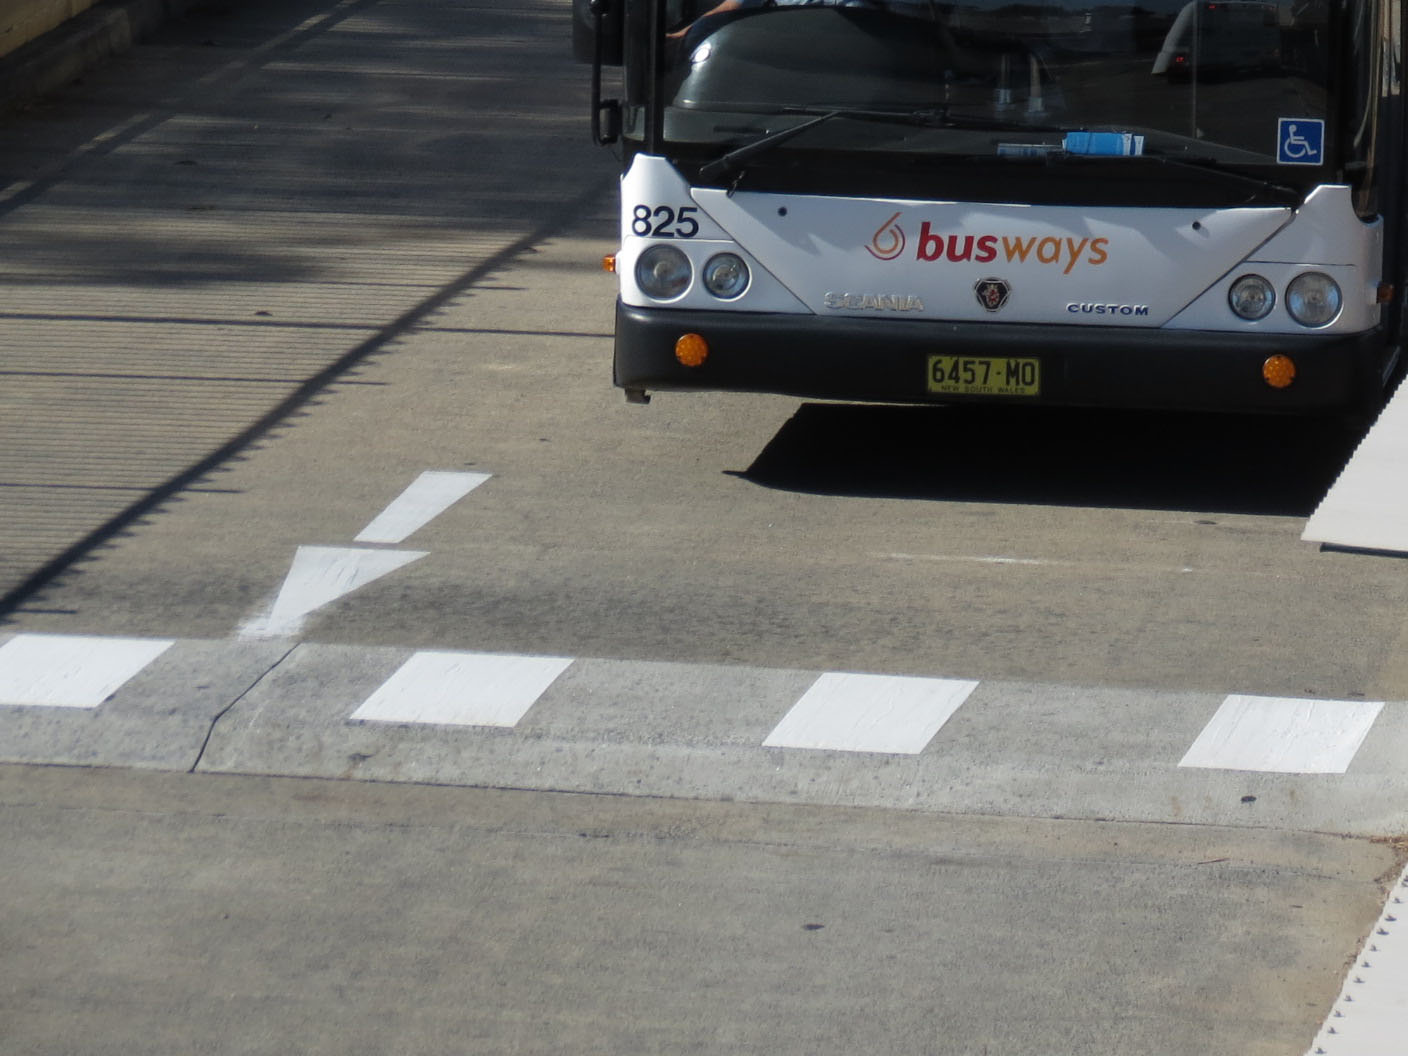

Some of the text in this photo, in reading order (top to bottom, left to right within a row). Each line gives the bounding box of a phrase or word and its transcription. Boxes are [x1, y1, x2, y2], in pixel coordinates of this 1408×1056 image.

[631, 204, 699, 239] 825
[916, 220, 1110, 274] busways
[823, 290, 925, 313] SCANIA
[1066, 302, 1150, 316] CUSTOM
